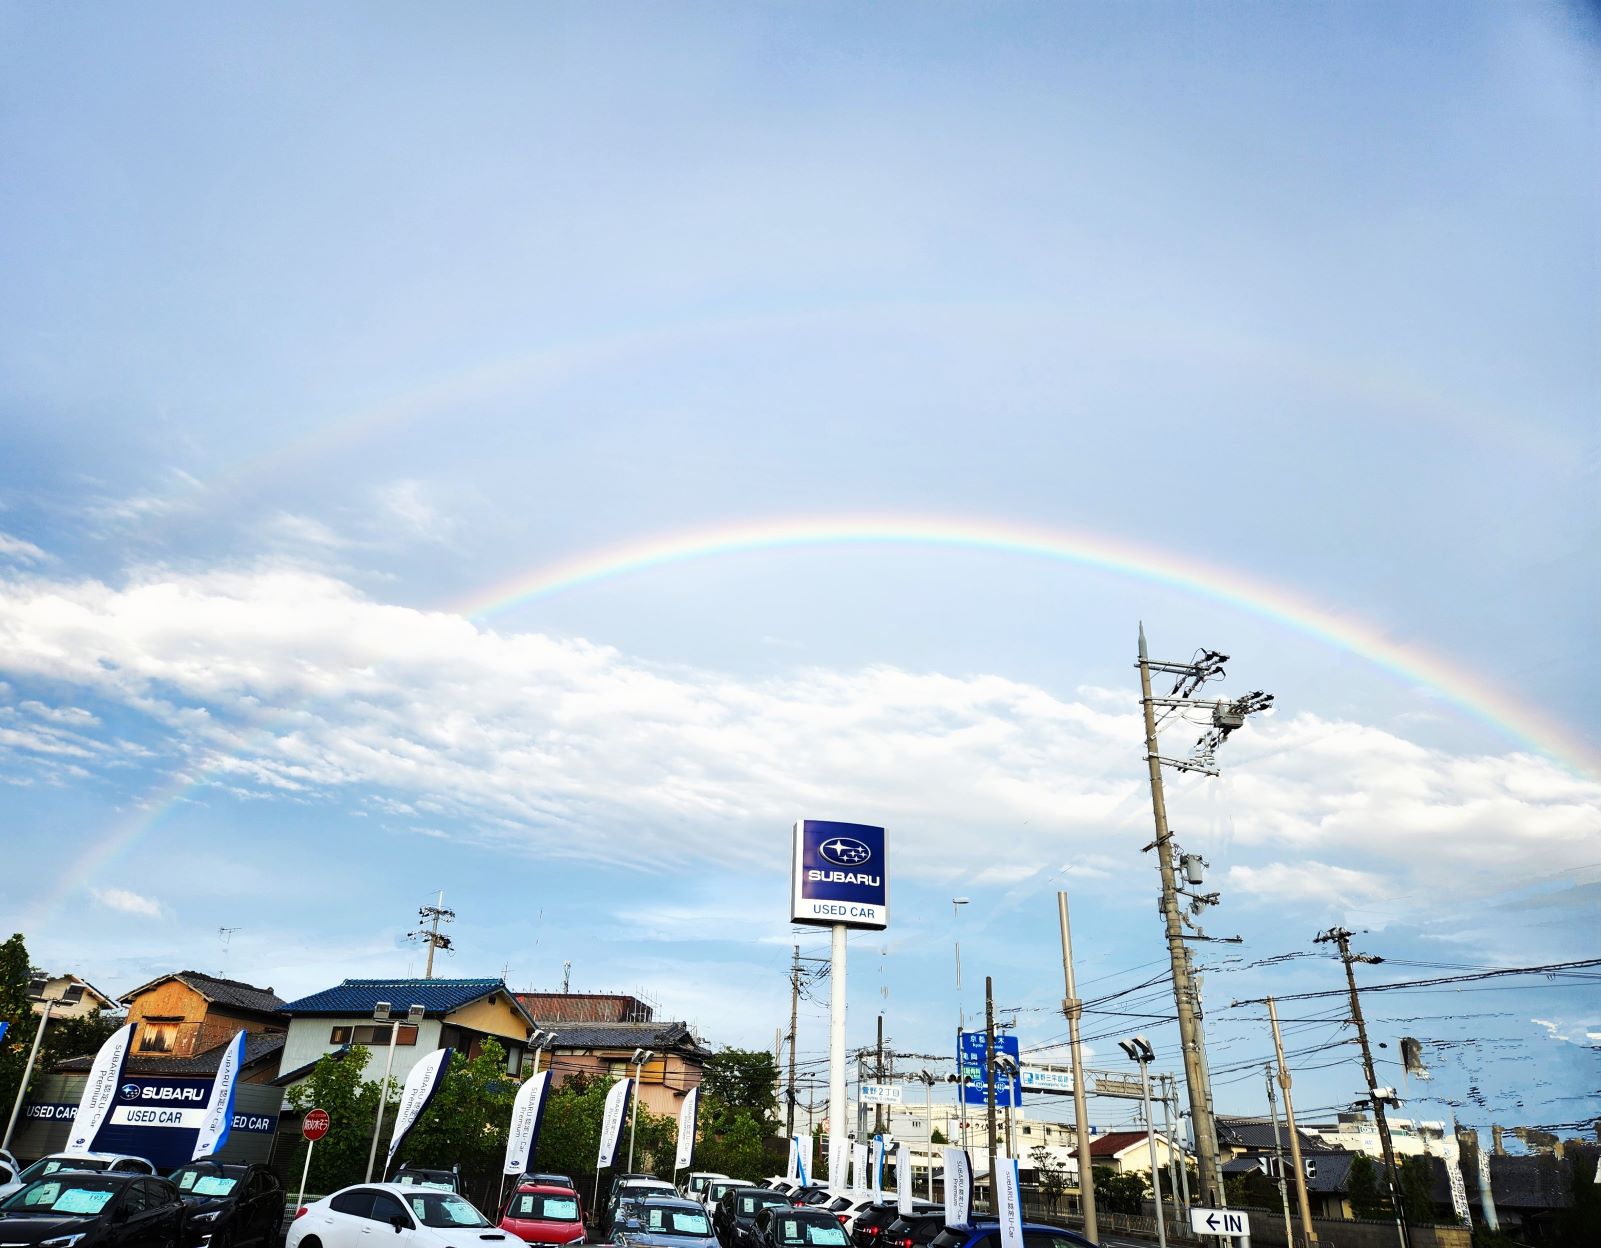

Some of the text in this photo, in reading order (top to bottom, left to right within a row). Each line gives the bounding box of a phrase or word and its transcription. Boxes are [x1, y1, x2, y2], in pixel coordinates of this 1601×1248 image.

[808, 870, 880, 887] SUBARU
[813, 904, 875, 919] USED CAR
[107, 1044, 122, 1082] SUBARU
[222, 1049, 233, 1087] SUBARU
[89, 1070, 107, 1109] Premium
[141, 1086, 205, 1101] SUBARU
[417, 1066, 434, 1100] SUBARU
[26, 1105, 78, 1119] USED CAR
[526, 1087, 538, 1117] SUBARU
[127, 1110, 183, 1124] USED CAR
[248, 1117, 270, 1130] CAR
[515, 1106, 527, 1138] Premium
[1005, 1170, 1013, 1202] SUBARU
[1223, 1214, 1243, 1233] IN
